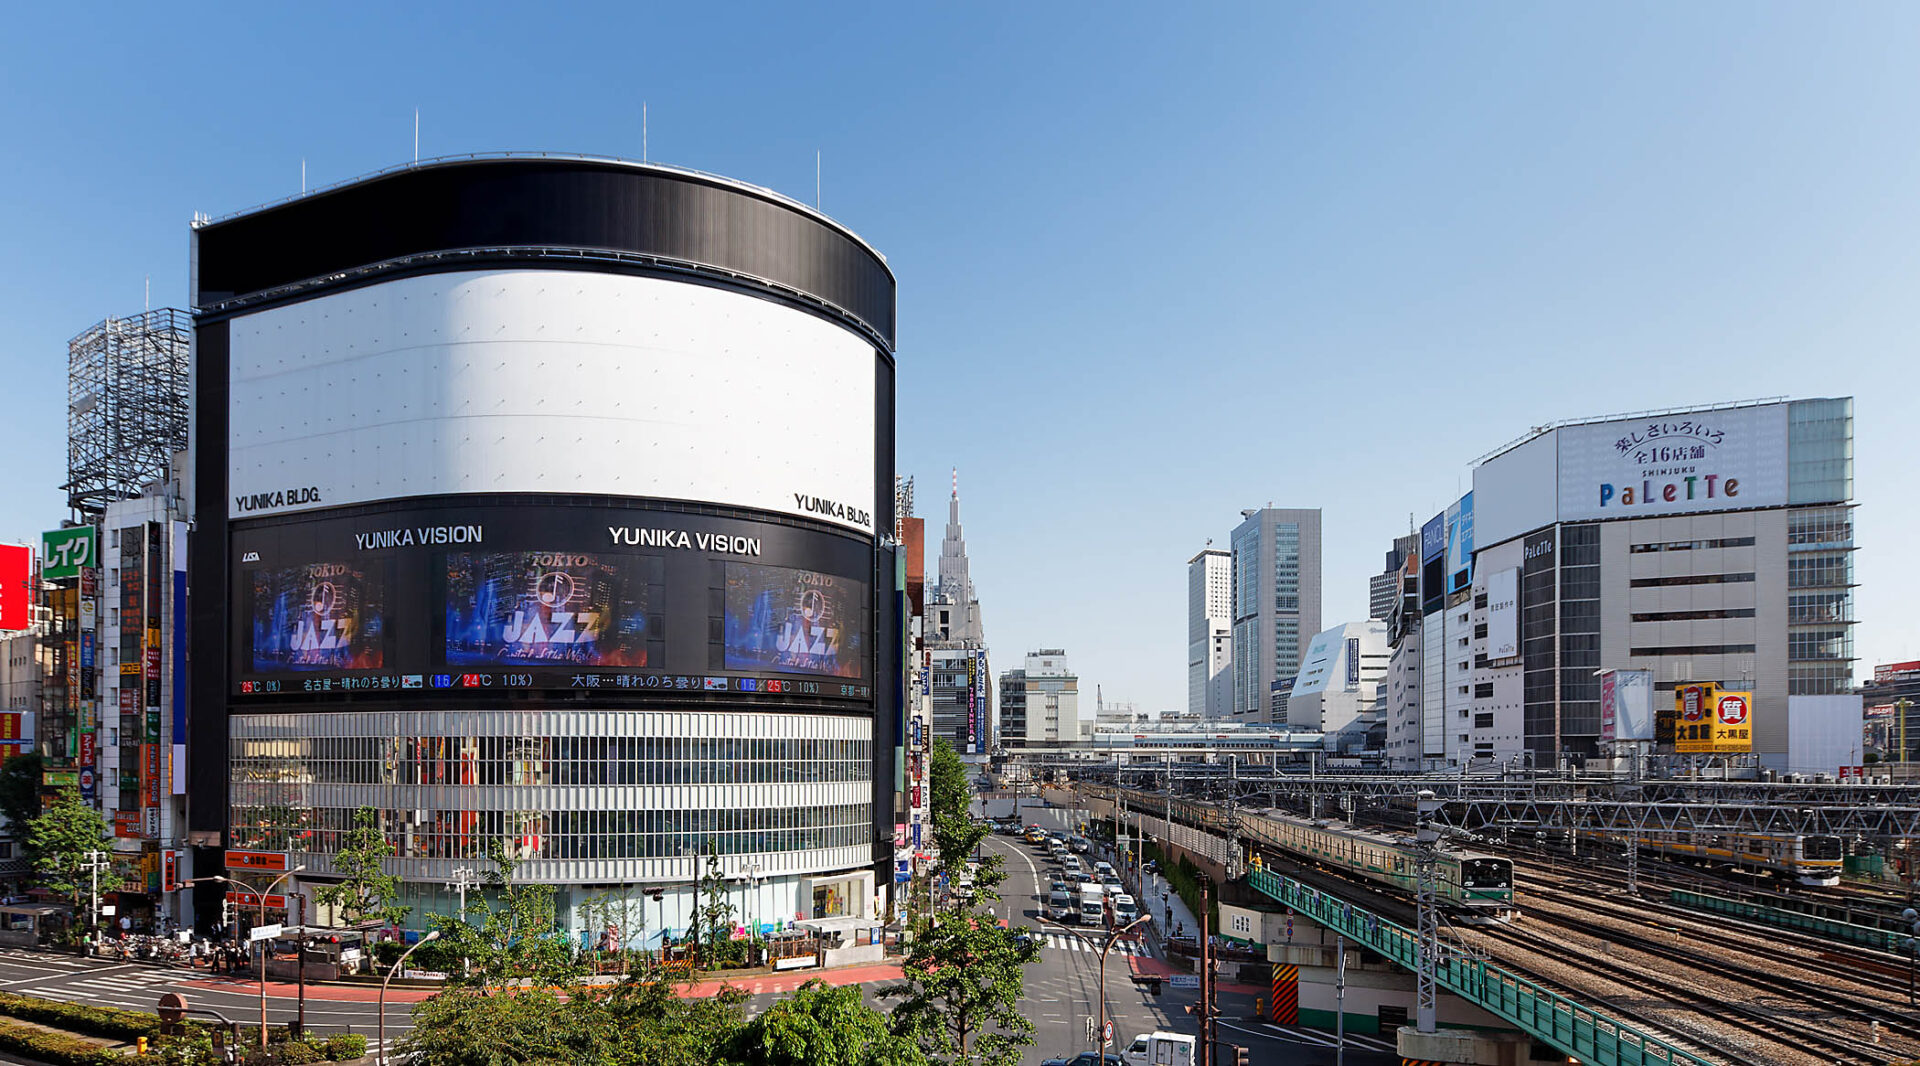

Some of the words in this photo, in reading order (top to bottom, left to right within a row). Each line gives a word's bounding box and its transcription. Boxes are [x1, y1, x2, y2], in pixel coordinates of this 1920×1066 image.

[1614, 421, 1725, 453] 楽しさいろいろ
[1633, 445, 1705, 464] 全16店舗
[1642, 466, 1696, 477] SHINJUKU
[236, 491, 284, 512] YUNIKA
[286, 486, 321, 505] BLDG.
[794, 493, 845, 519] YUNIKA
[355, 528, 414, 550] YUNIKA
[417, 525, 482, 544] VISION
[608, 526, 692, 549] YUNIKA
[695, 532, 761, 556] VISION
[44, 537, 88, 568] レイク
[530, 553, 589, 567] TOKYO
[308, 563, 345, 578] TOKYO
[798, 572, 833, 587] TOKYO
[290, 618, 352, 651] JAZZ
[502, 611, 600, 643] JAZZ
[776, 621, 839, 655] JAZZ
[1685, 691, 1699, 716] 質
[1722, 701, 1743, 720] 質
[1716, 729, 1749, 739] 大黒屋
